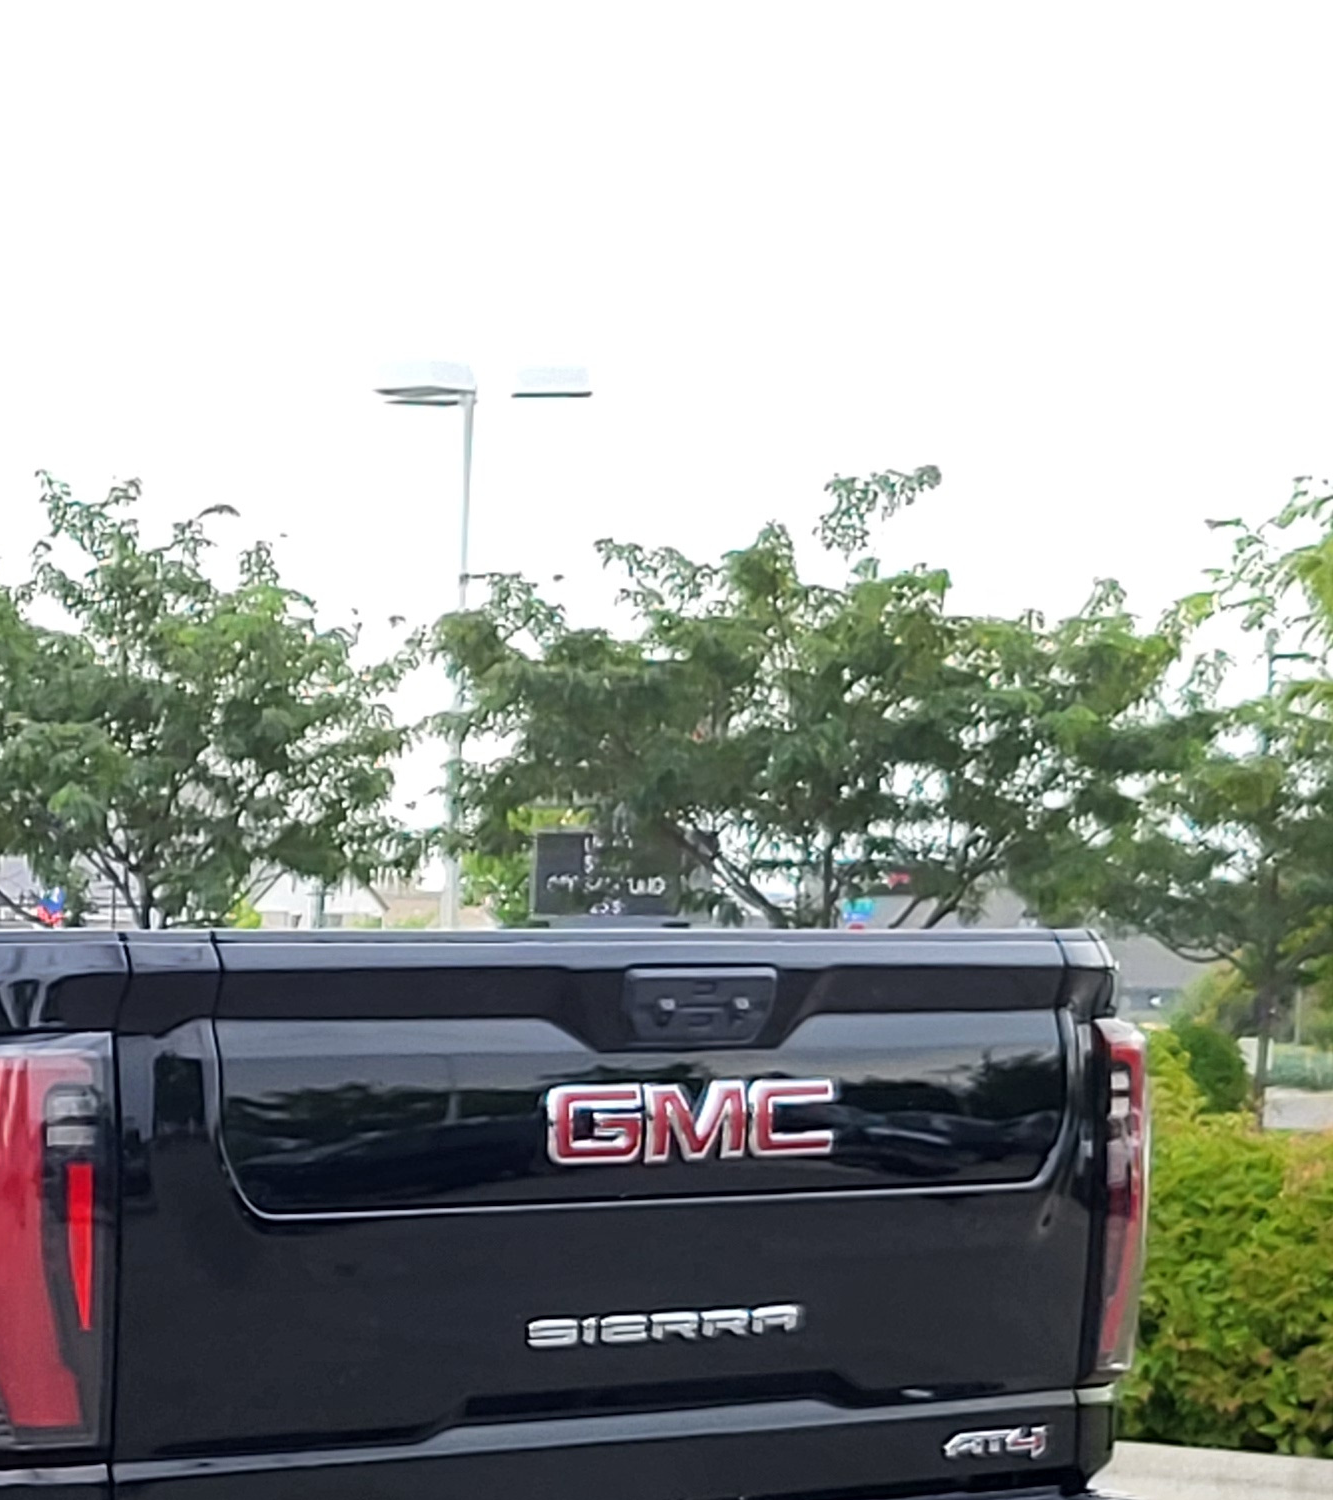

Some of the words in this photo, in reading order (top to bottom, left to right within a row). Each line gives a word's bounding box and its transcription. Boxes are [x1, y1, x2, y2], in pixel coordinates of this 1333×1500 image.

[545, 1078, 834, 1166] GMC
[527, 1303, 801, 1348] SIERRA
[942, 1424, 1048, 1460] AT4
